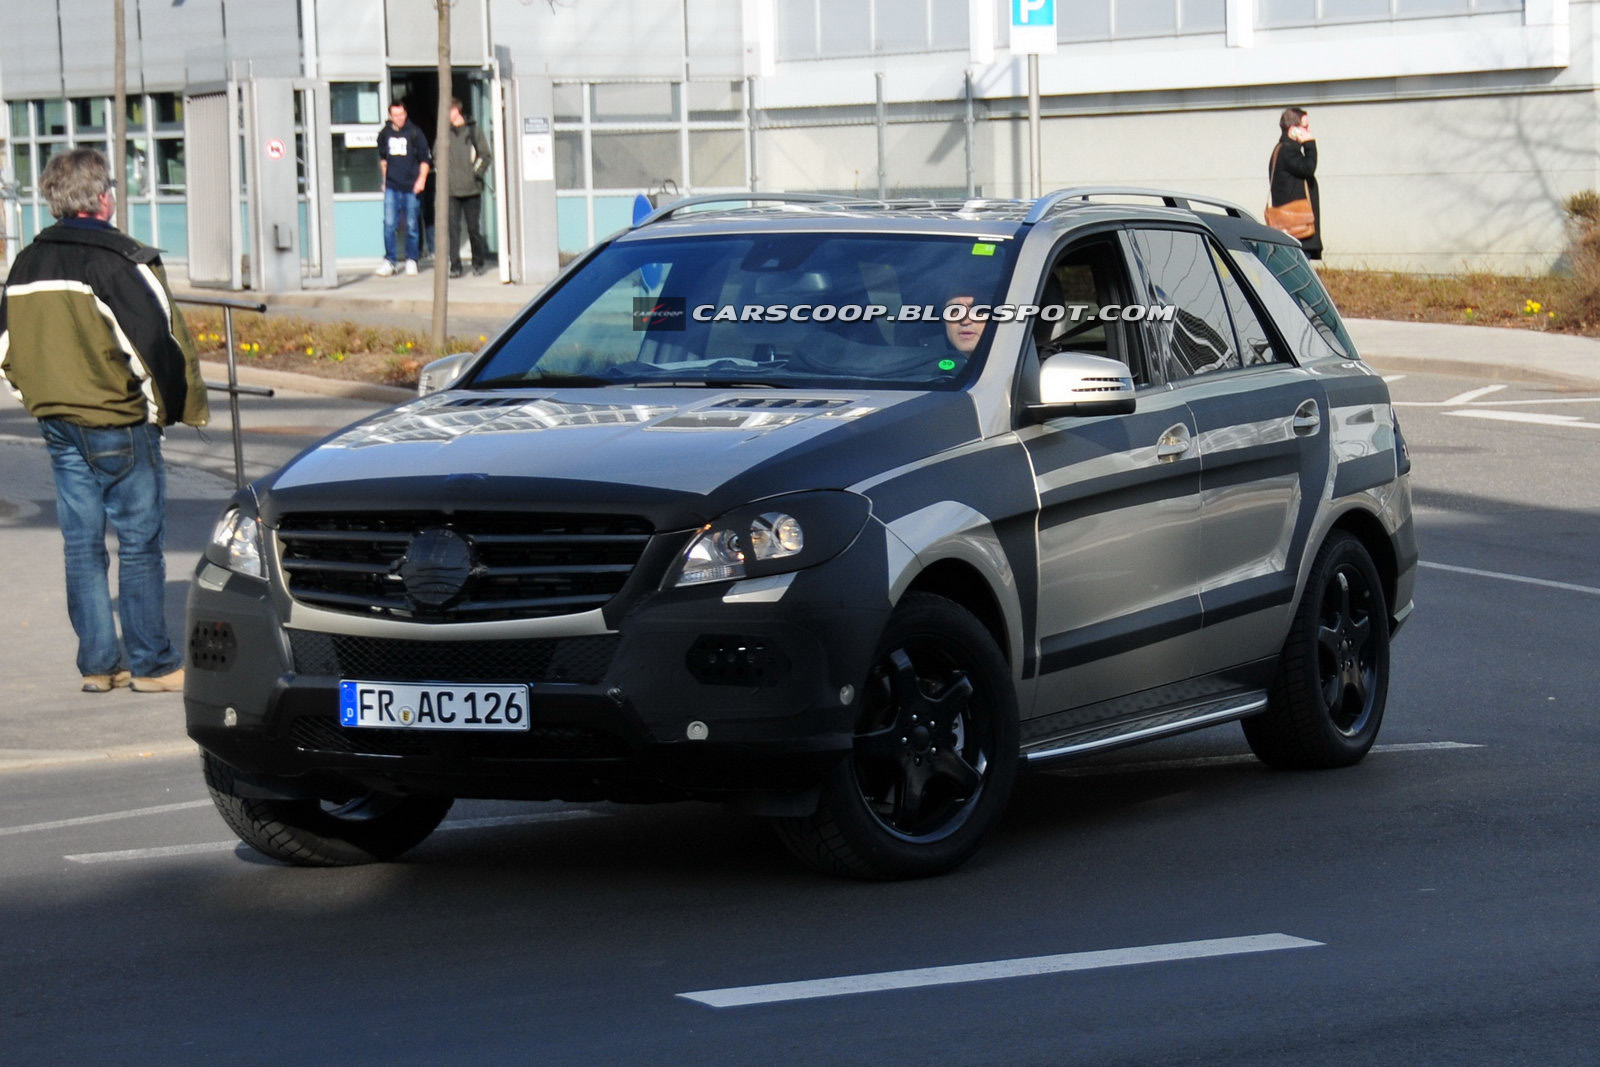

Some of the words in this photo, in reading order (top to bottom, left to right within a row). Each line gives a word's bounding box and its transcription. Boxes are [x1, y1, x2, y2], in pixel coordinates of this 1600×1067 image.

[1020, 0, 1046, 23] P
[346, 707, 354, 717] D
[359, 688, 397, 722] FR
[417, 691, 457, 723] AC
[464, 691, 523, 724] 126
